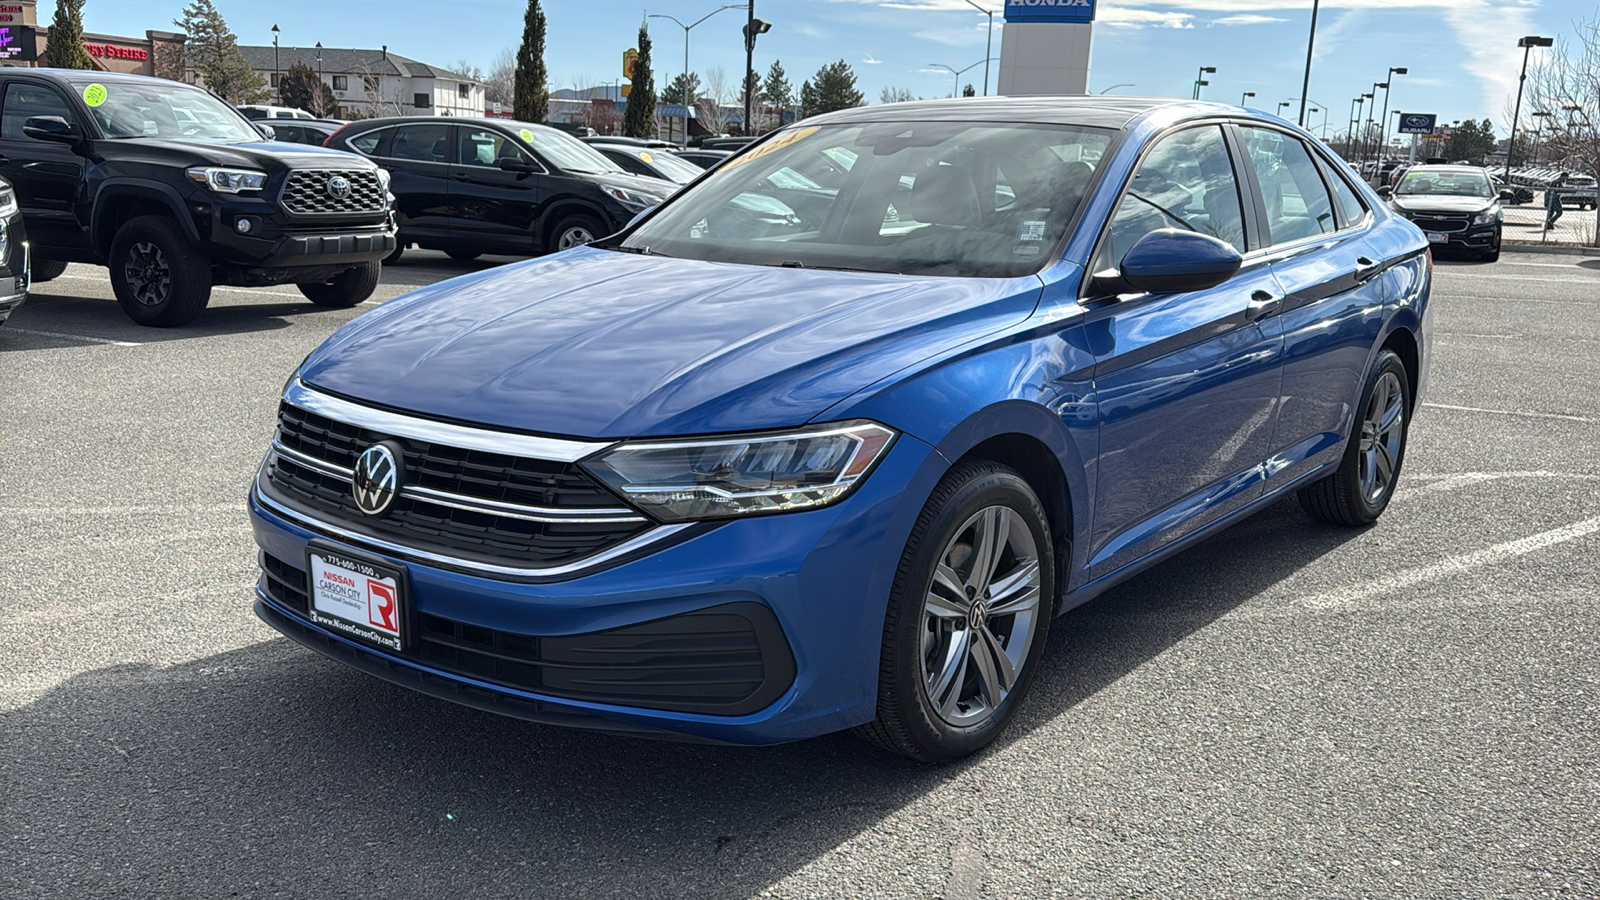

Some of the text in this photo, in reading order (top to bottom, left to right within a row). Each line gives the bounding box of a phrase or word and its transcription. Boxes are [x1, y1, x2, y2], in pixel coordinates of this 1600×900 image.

[327, 555, 374, 576] 775-600-1500
[323, 571, 355, 587] NISSAN
[319, 580, 361, 599] CARSON CITY
[318, 616, 393, 645] www.NissanCarsonCity.com
